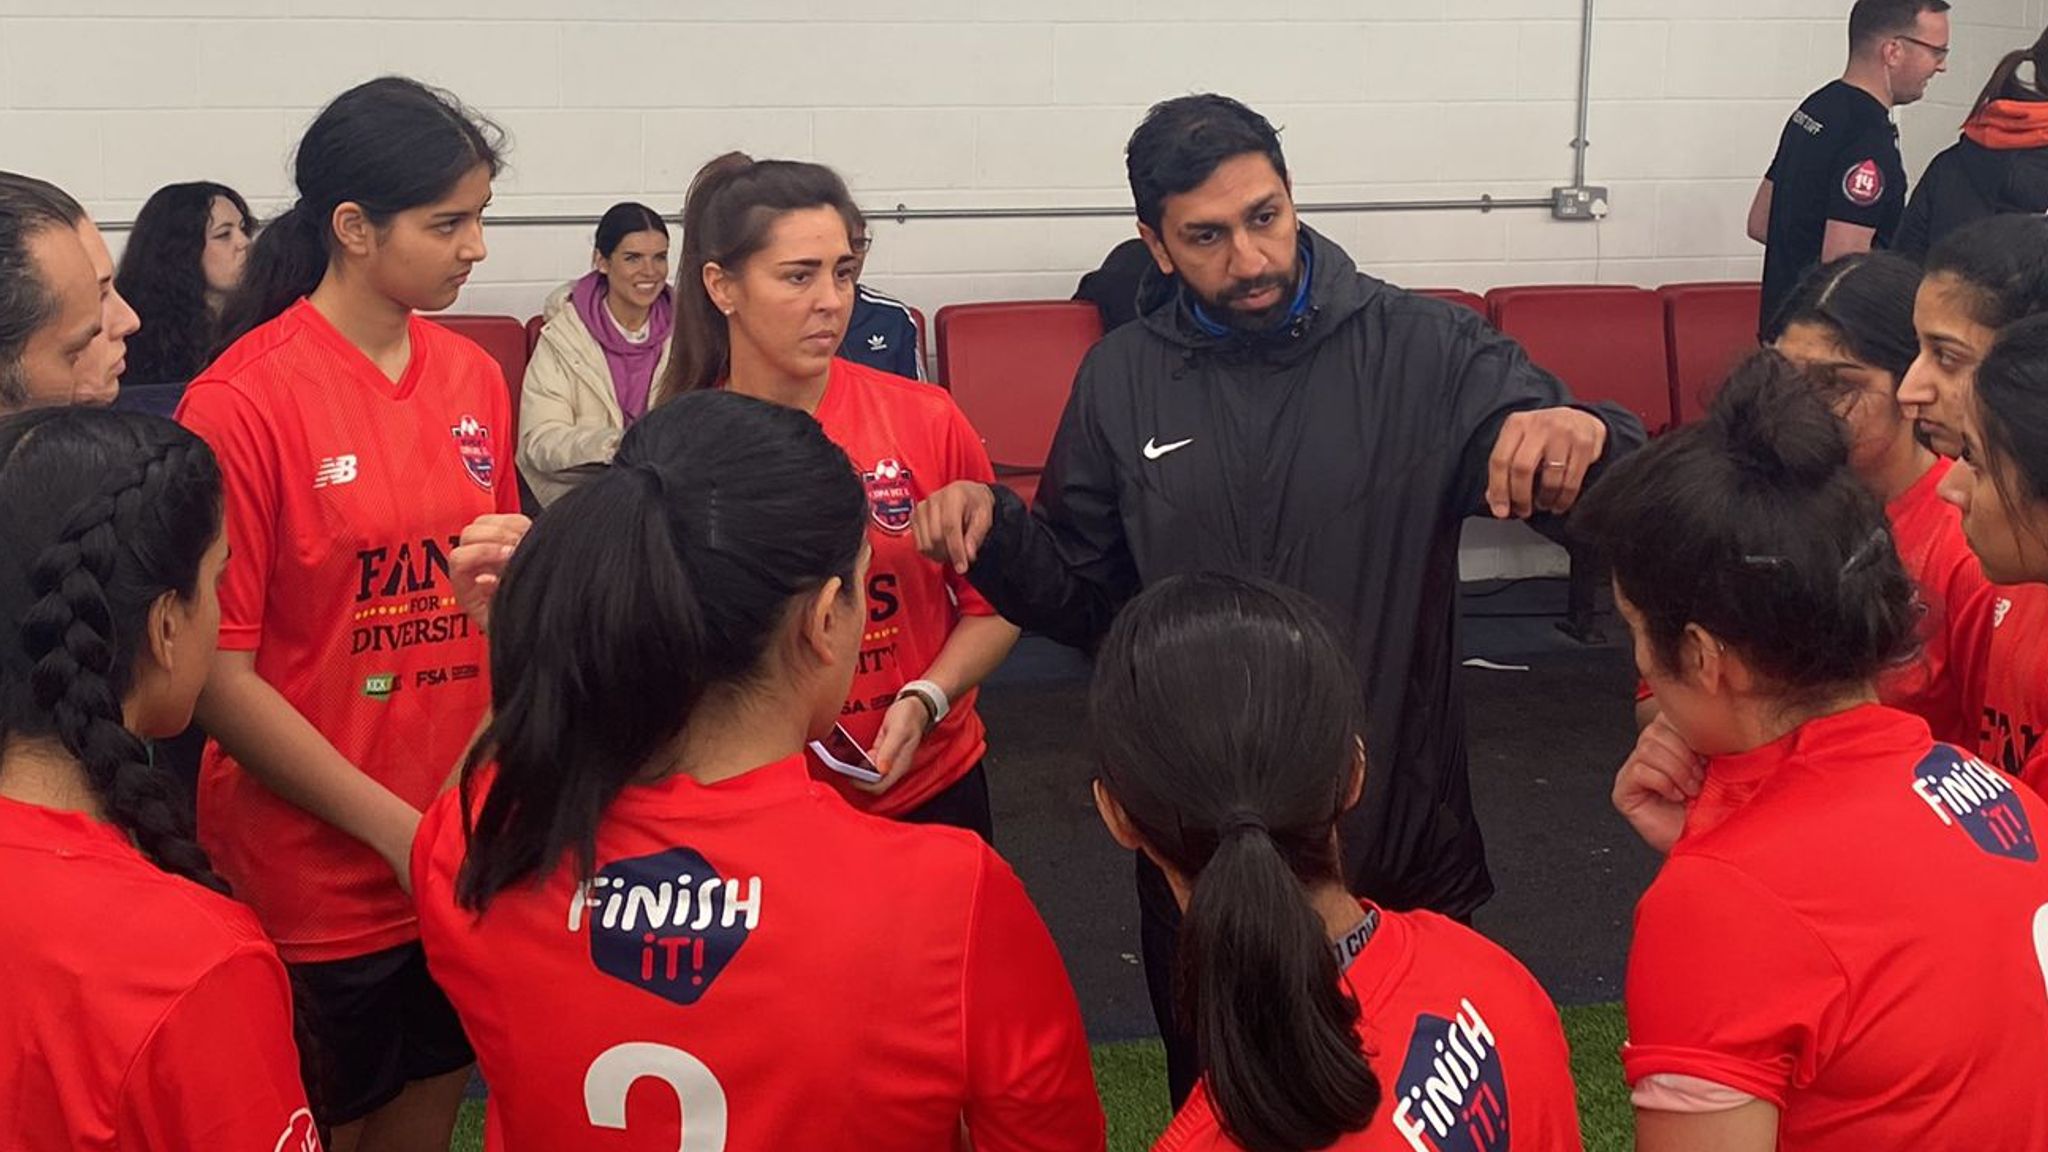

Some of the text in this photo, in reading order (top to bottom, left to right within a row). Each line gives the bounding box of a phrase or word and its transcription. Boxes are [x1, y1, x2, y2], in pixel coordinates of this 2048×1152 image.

[1855, 173, 1874, 191] 14
[356, 536, 461, 602] FAN
[410, 596, 440, 613] FOR
[350, 612, 485, 655] DIVERSIT
[416, 668, 449, 688] FSA
[1912, 756, 2013, 826] FiNiSH
[1981, 803, 2031, 850] iT!
[568, 874, 761, 932] FiNiSH
[641, 932, 704, 986] iT!
[1392, 998, 1496, 1152] FiNiSH
[1462, 1083, 1506, 1152] iT!
